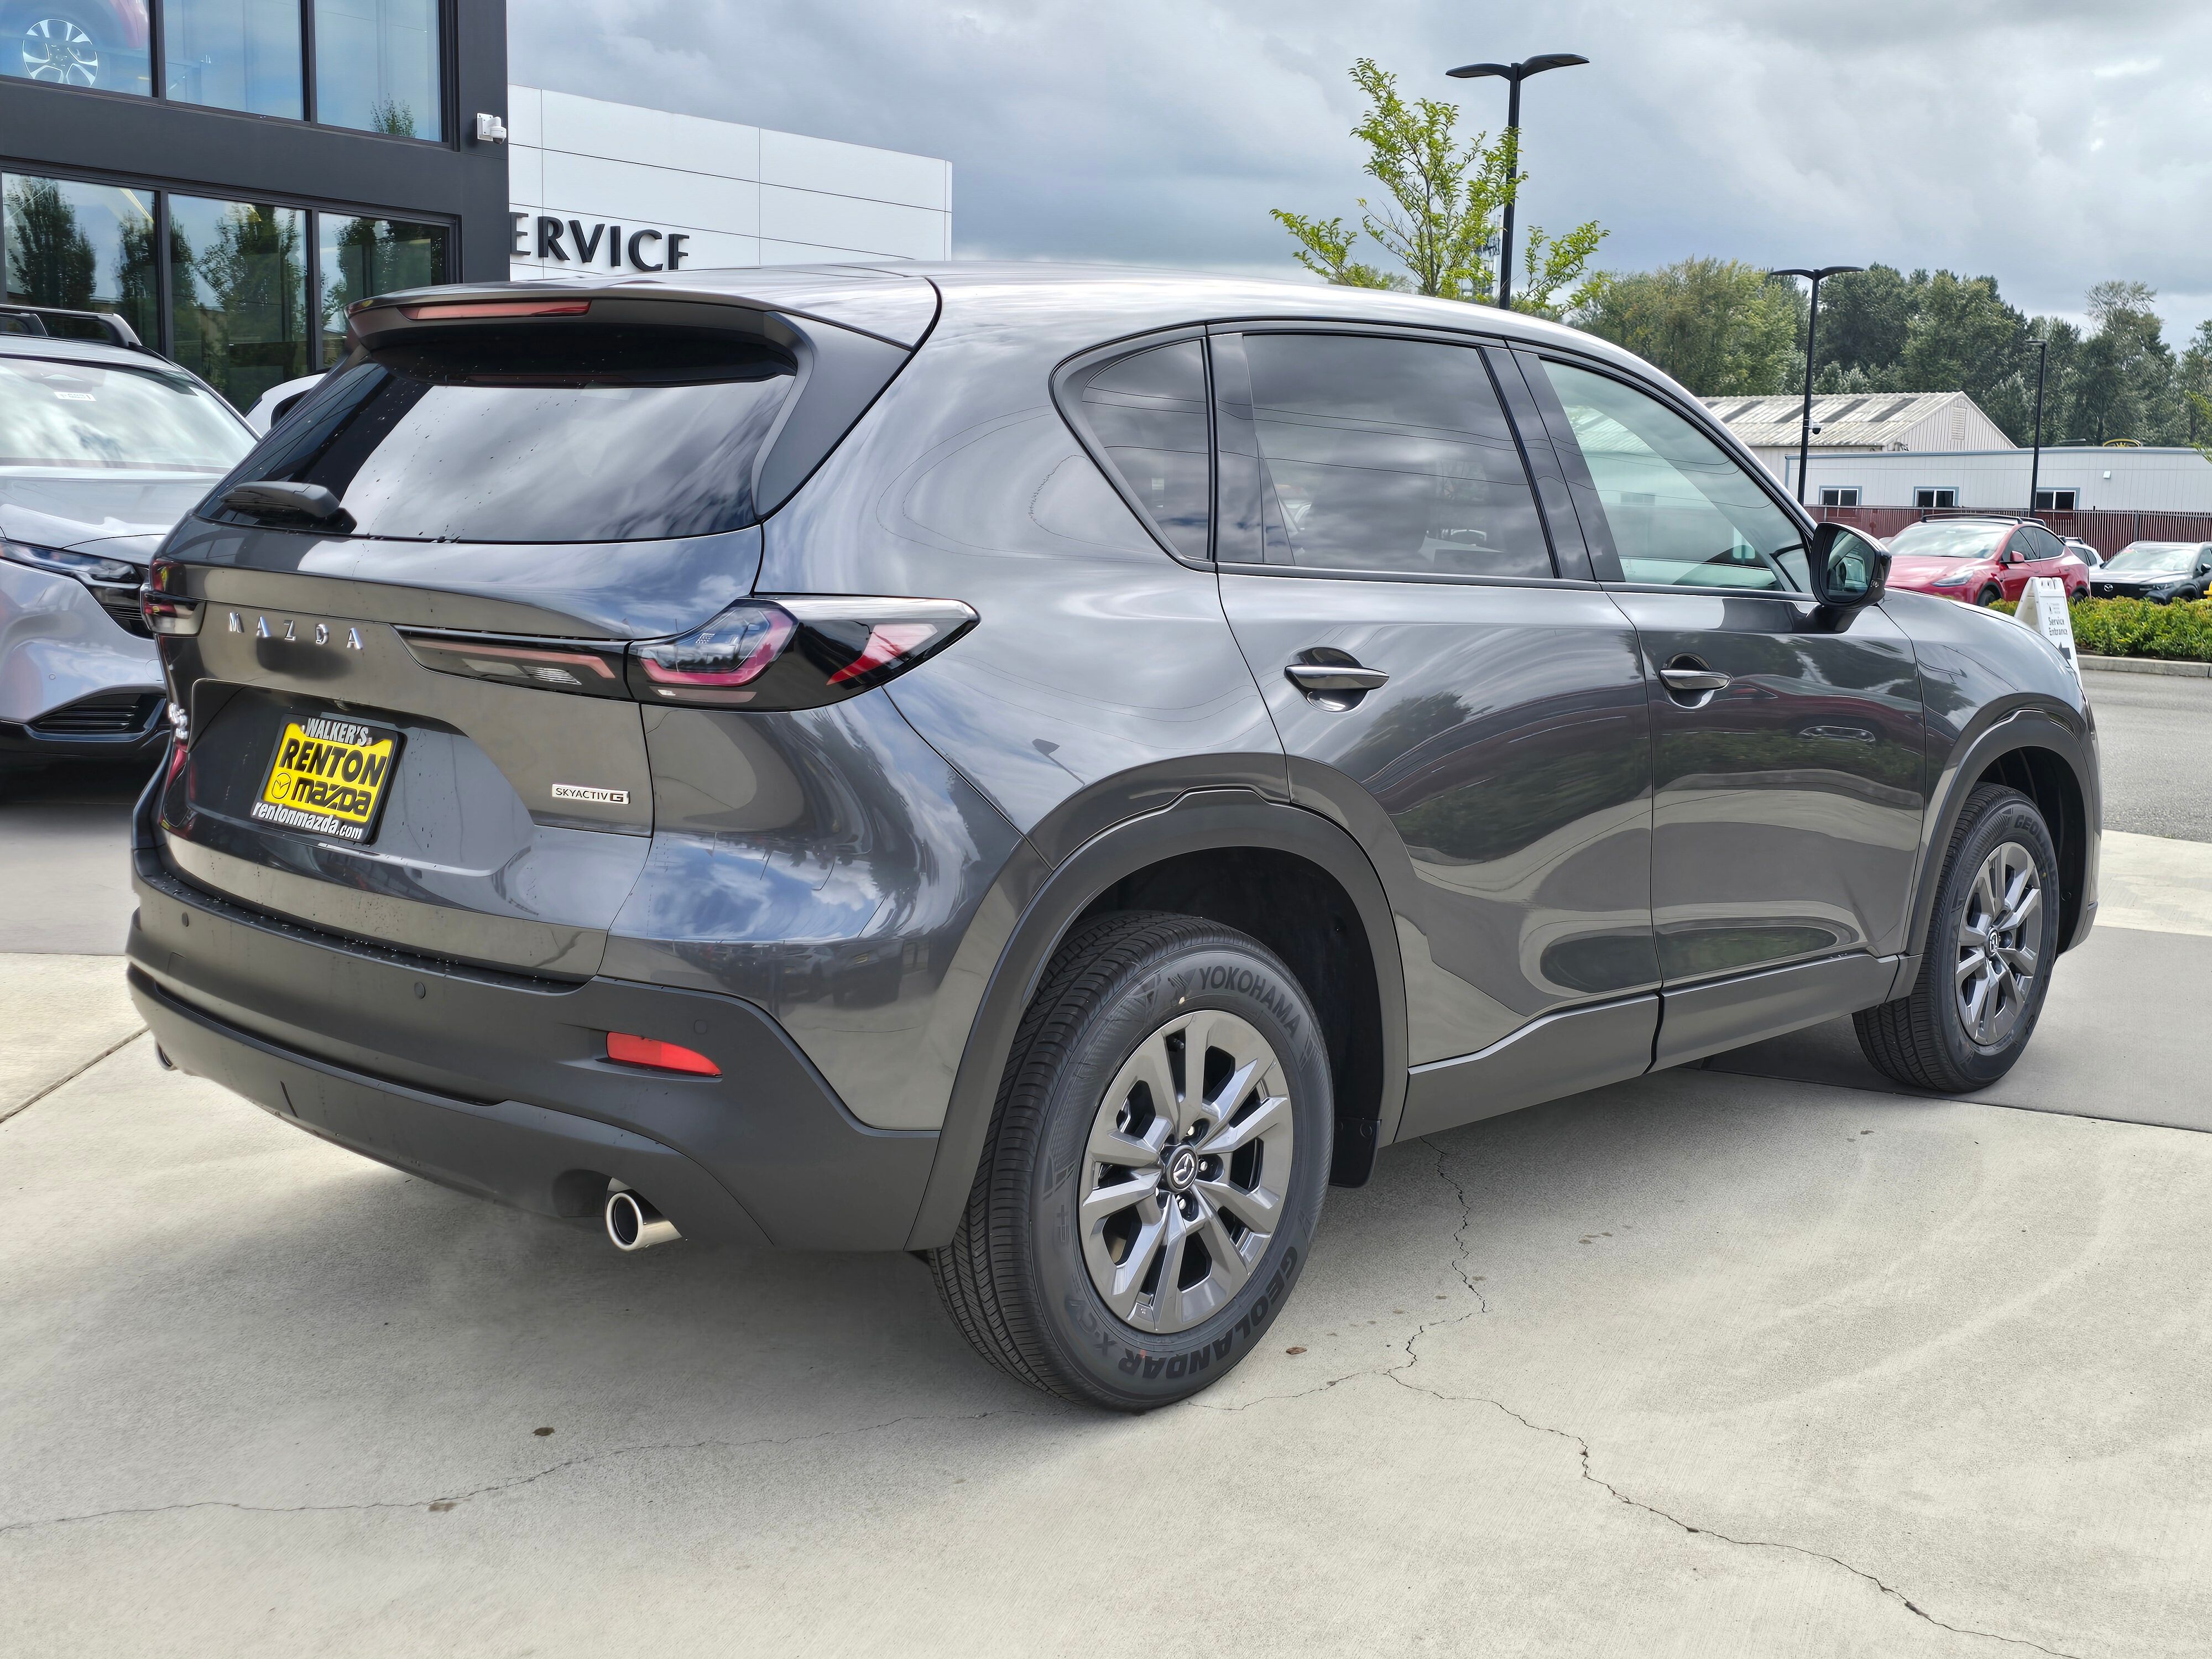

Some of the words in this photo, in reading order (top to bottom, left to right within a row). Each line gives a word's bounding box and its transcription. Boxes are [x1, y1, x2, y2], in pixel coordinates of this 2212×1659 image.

[228, 611, 363, 650] MAZDA
[2048, 617, 2065, 625] Service
[304, 718, 369, 747] WALKER'S
[278, 737, 387, 787] RENTON
[555, 787, 608, 800] SKYACTIV
[252, 802, 363, 839] rentonmazda.com
[1199, 965, 1301, 1039] YOKOHAMA
[1118, 1245, 1298, 1379] GEOLANDAR
